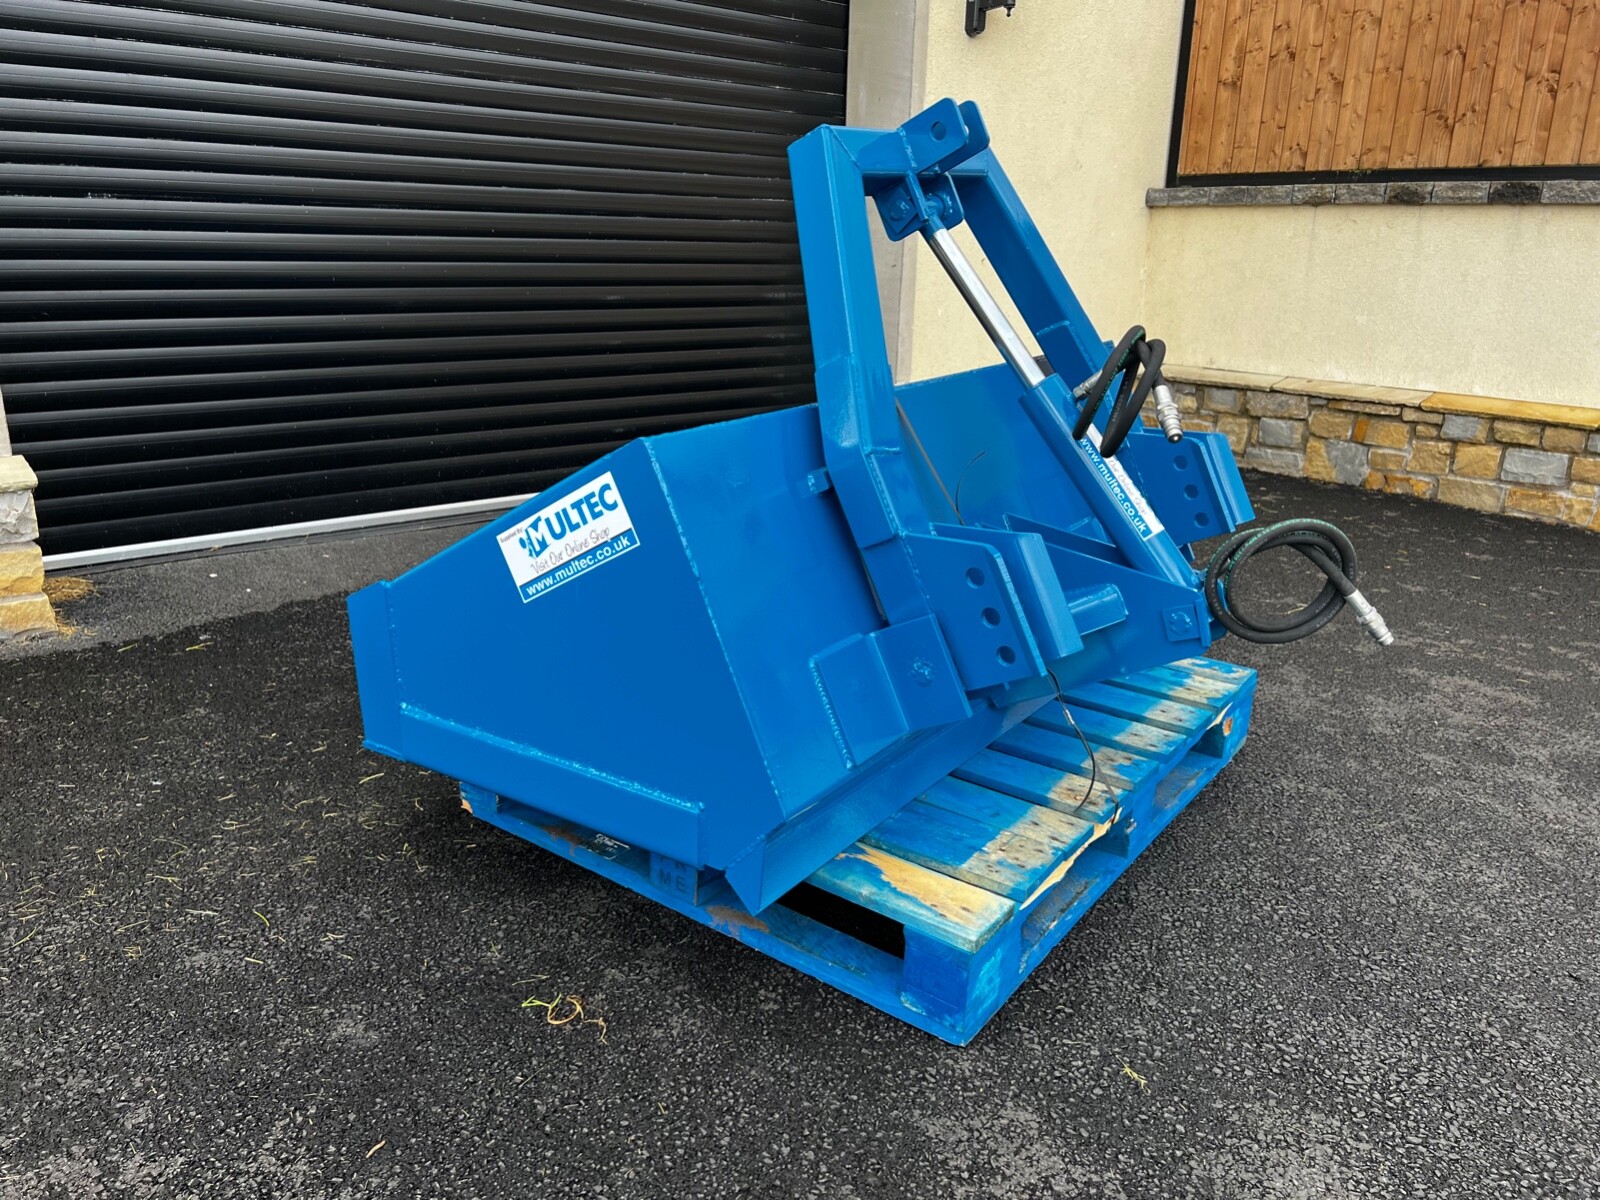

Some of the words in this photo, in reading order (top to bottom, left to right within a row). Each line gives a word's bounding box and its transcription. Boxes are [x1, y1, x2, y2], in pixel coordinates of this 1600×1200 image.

[522, 483, 618, 558] MULTEC
[530, 560, 549, 575] Visit
[549, 550, 564, 565] Our
[564, 537, 590, 557] Online
[589, 527, 610, 543] Shop
[526, 535, 631, 596] www.multec.co.uk
